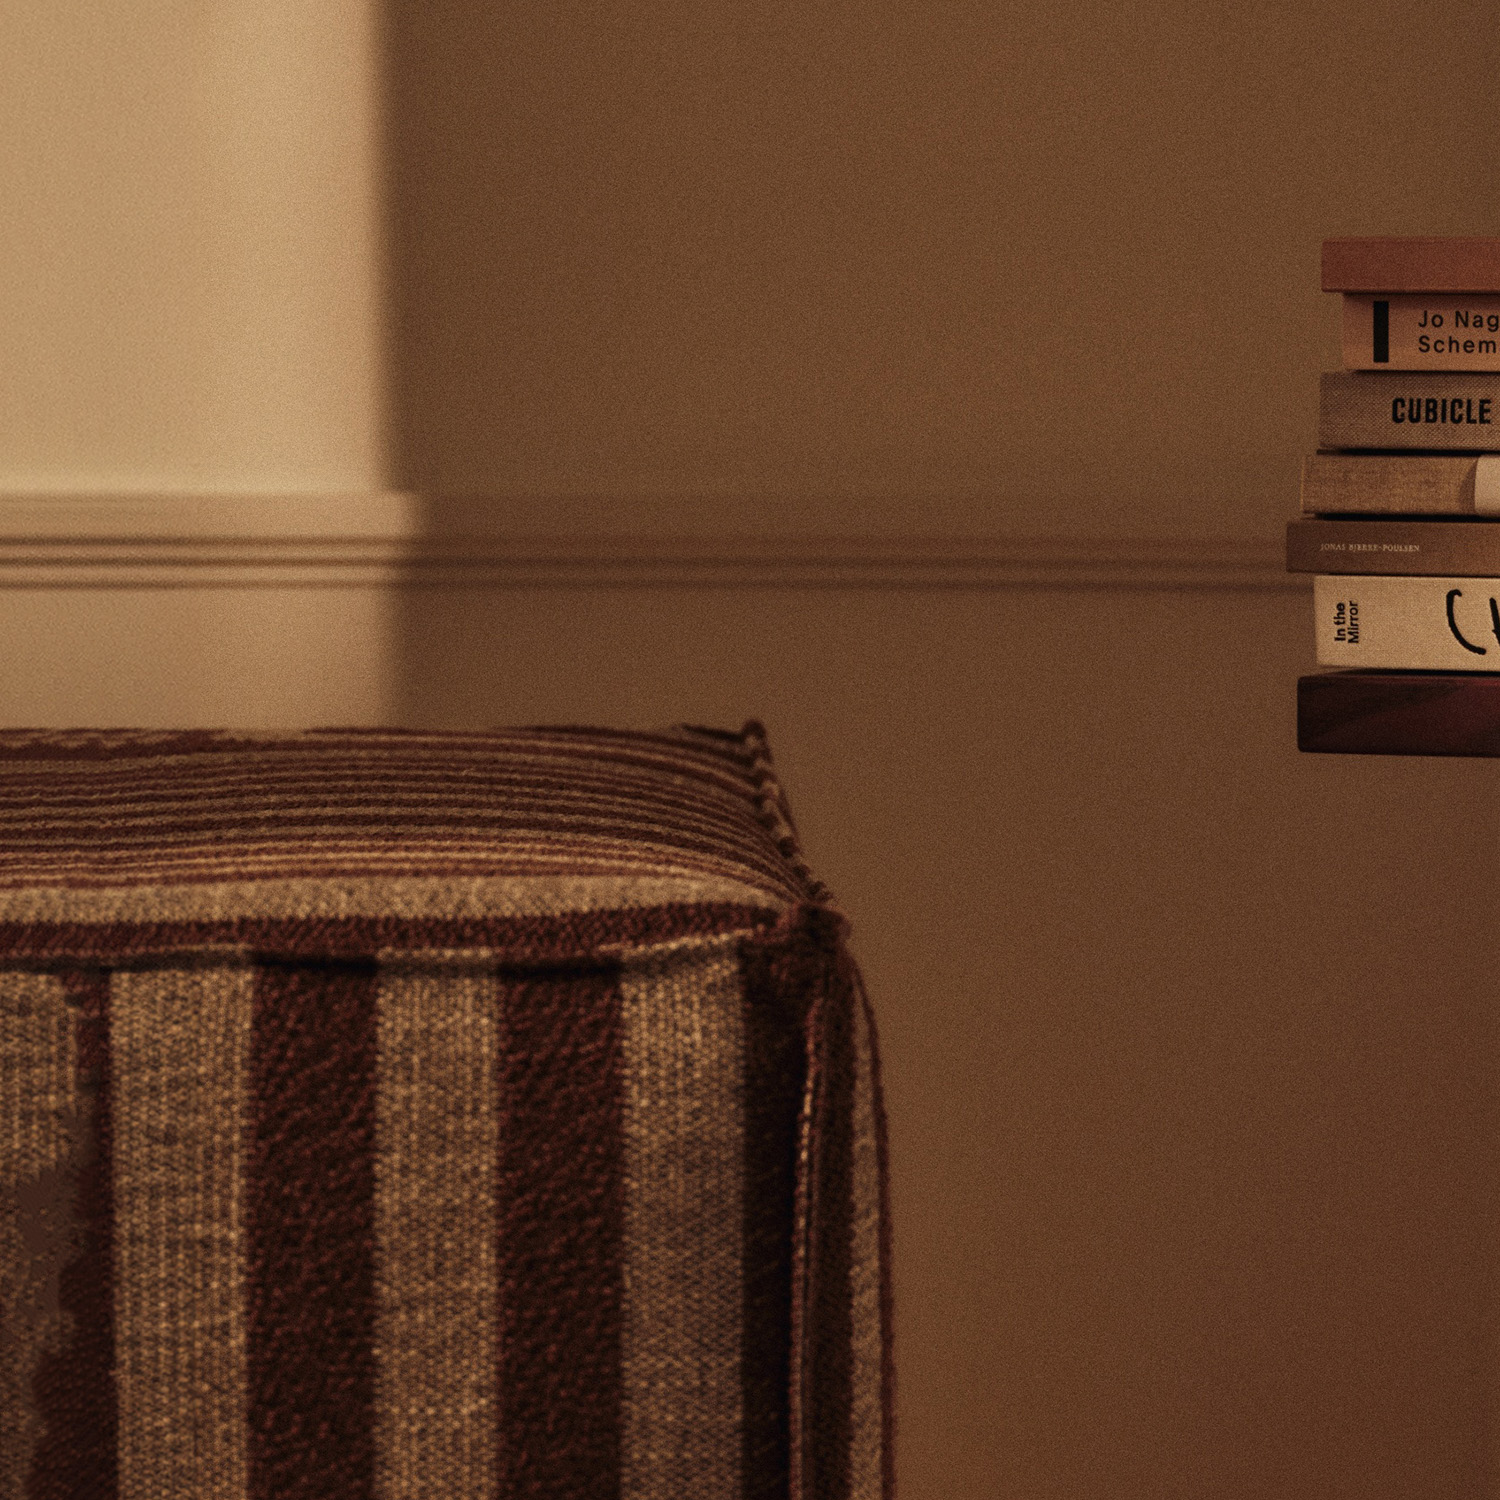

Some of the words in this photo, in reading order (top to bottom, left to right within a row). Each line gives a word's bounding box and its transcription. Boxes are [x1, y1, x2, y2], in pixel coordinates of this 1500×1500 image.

[1418, 310, 1444, 328] Jo
[1392, 397, 1492, 424] CUBICLE
[1320, 543, 1346, 551] JONAS
[1333, 602, 1346, 625] the
[1347, 600, 1359, 644] Mirror
[1333, 628, 1346, 642] In
